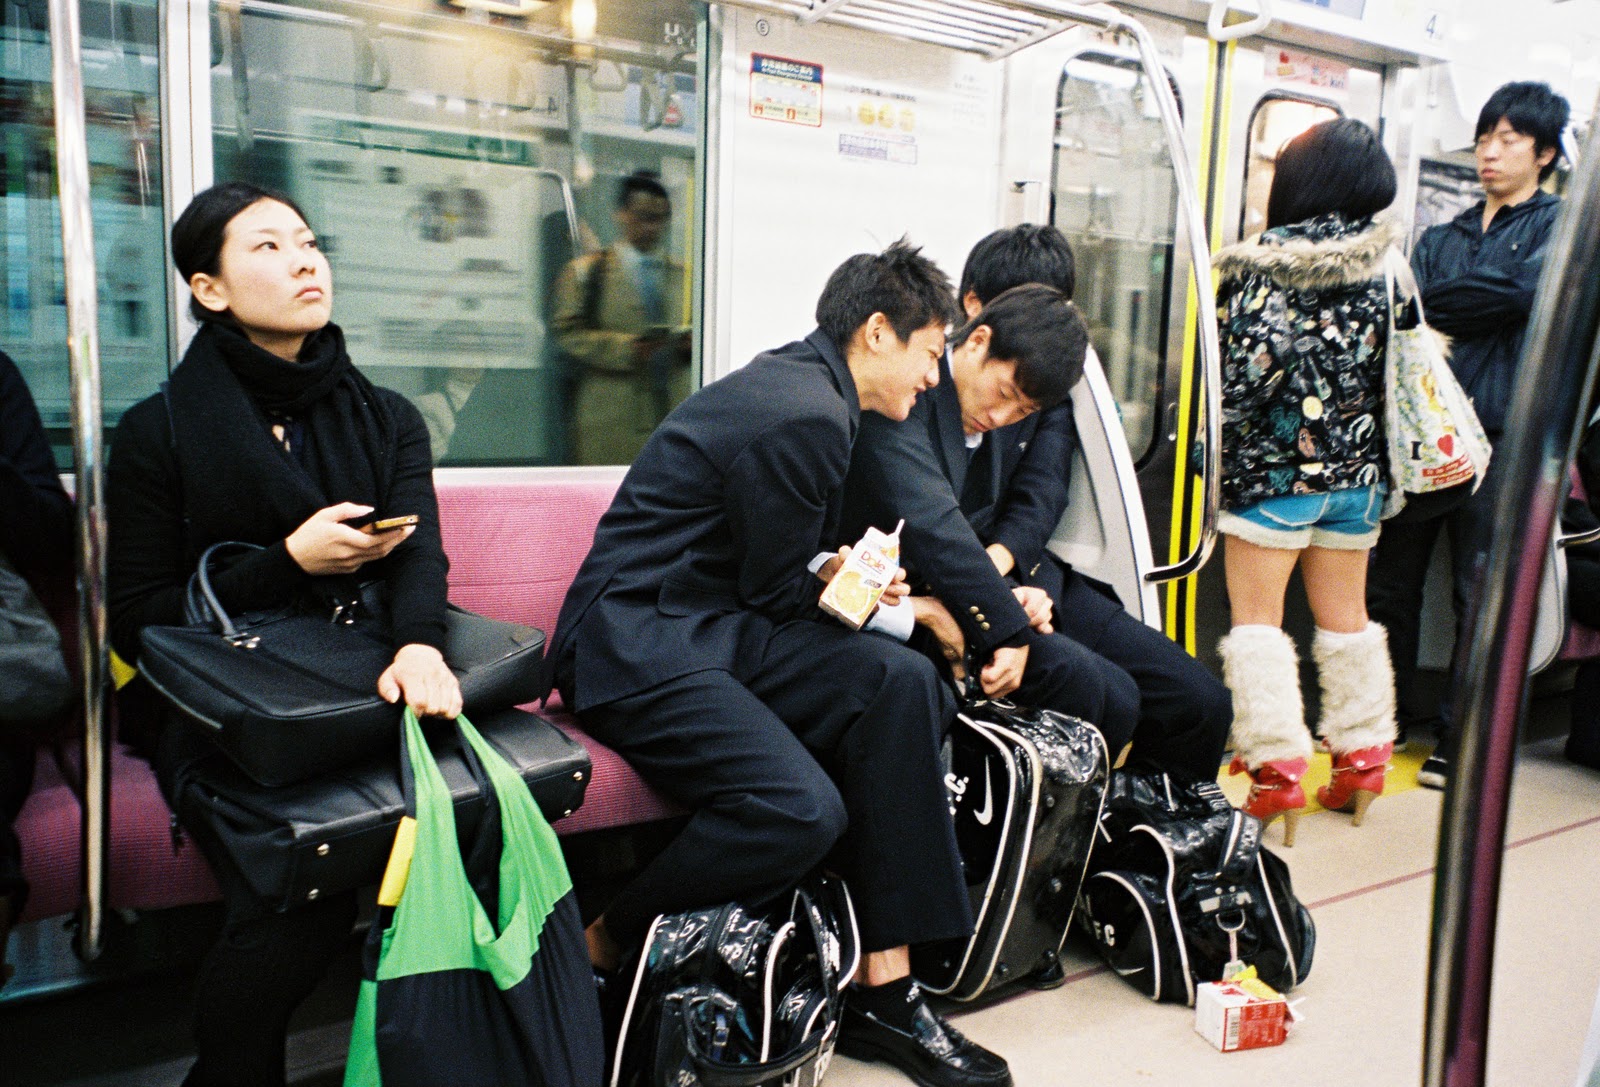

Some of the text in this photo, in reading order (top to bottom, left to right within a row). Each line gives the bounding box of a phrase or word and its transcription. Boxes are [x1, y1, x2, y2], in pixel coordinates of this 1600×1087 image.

[1426, 14, 1437, 39] 4
[1411, 440, 1422, 460] I
[860, 551, 886, 573] Dole
